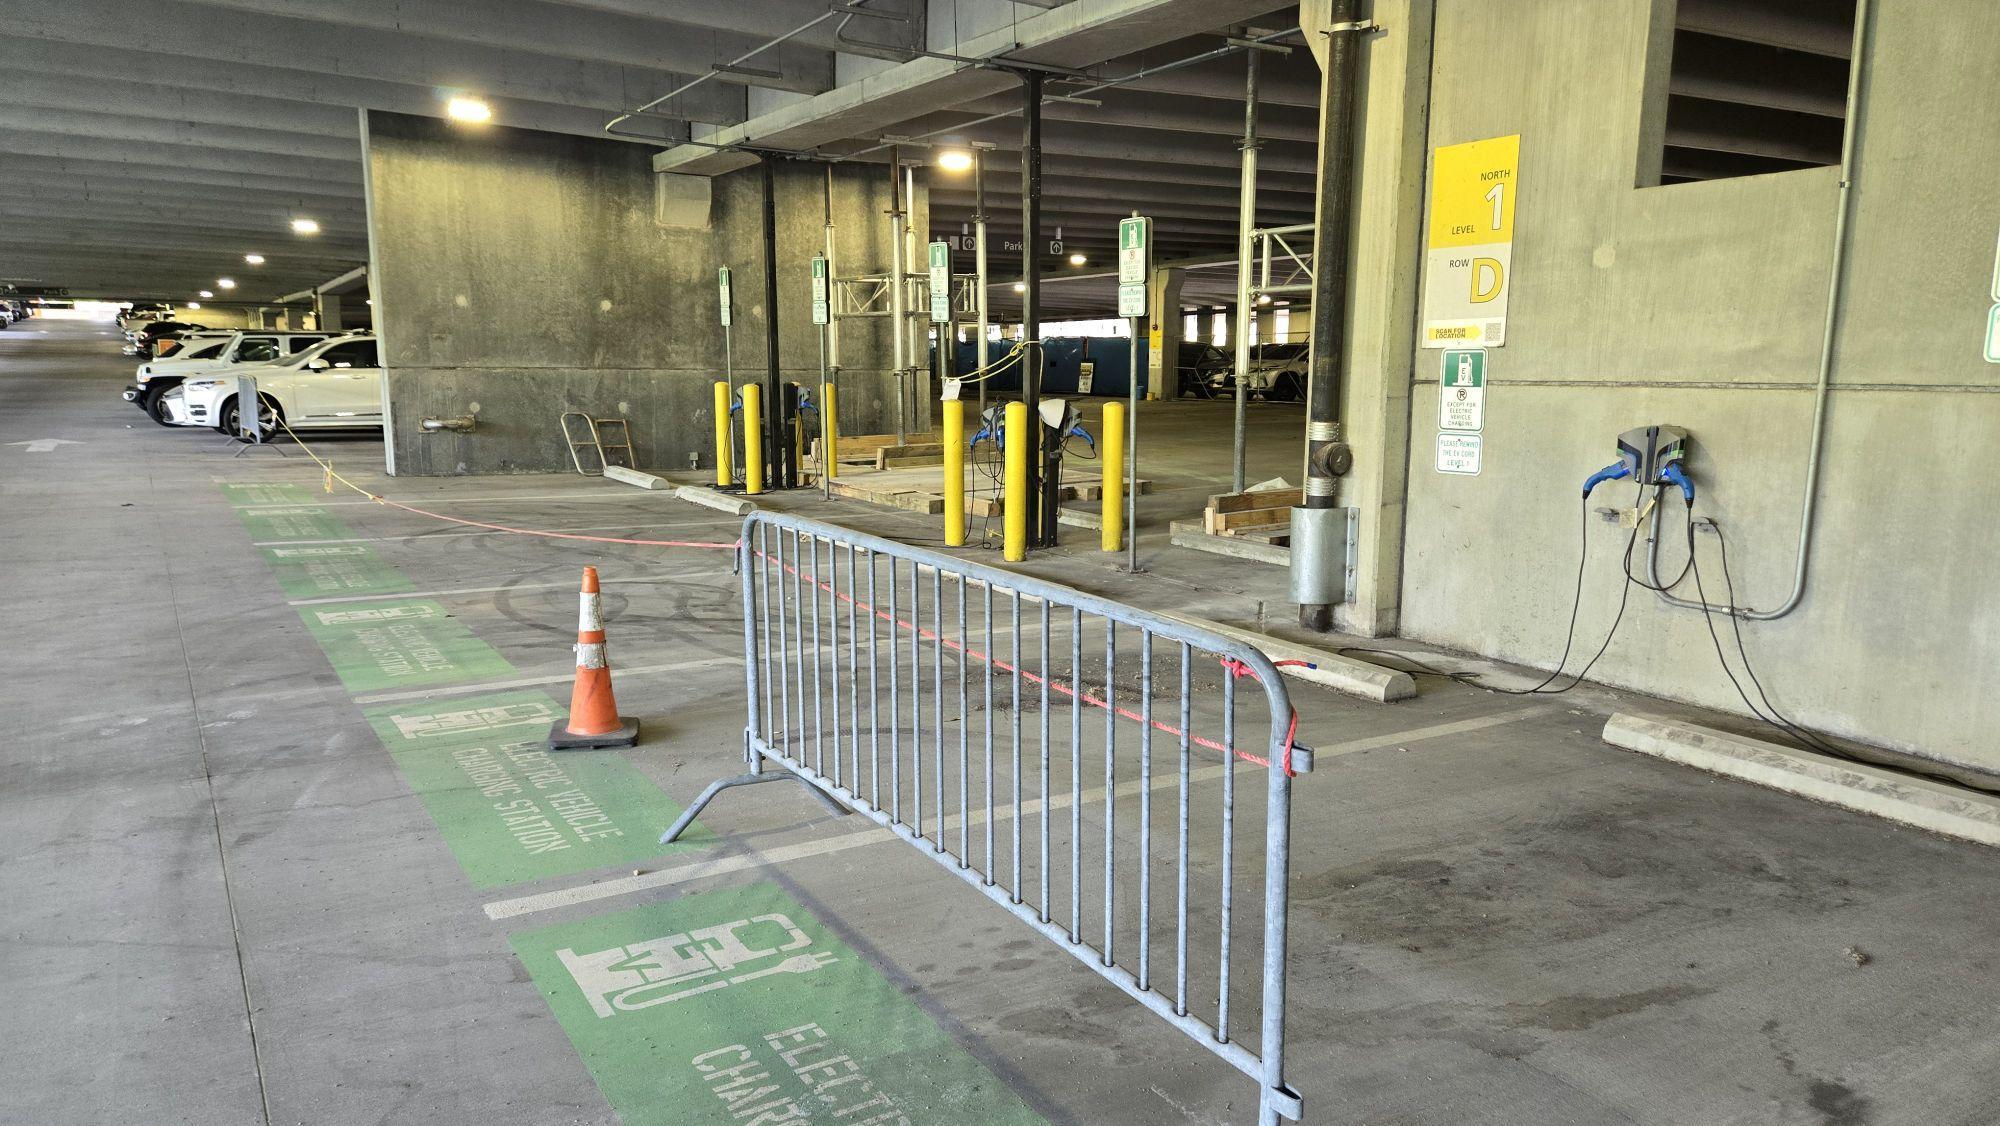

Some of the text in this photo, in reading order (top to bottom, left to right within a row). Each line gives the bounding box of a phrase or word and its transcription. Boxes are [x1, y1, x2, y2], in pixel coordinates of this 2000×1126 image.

[1480, 169, 1511, 181] NORTH
[1451, 182, 1504, 235] LEVEL 1
[1449, 257, 1504, 303] ROW D
[1440, 439, 1458, 447] PLEASE
[452, 747, 572, 855] CHARGING STATION
[499, 741, 624, 843] ELECTRIC VEHICLE
